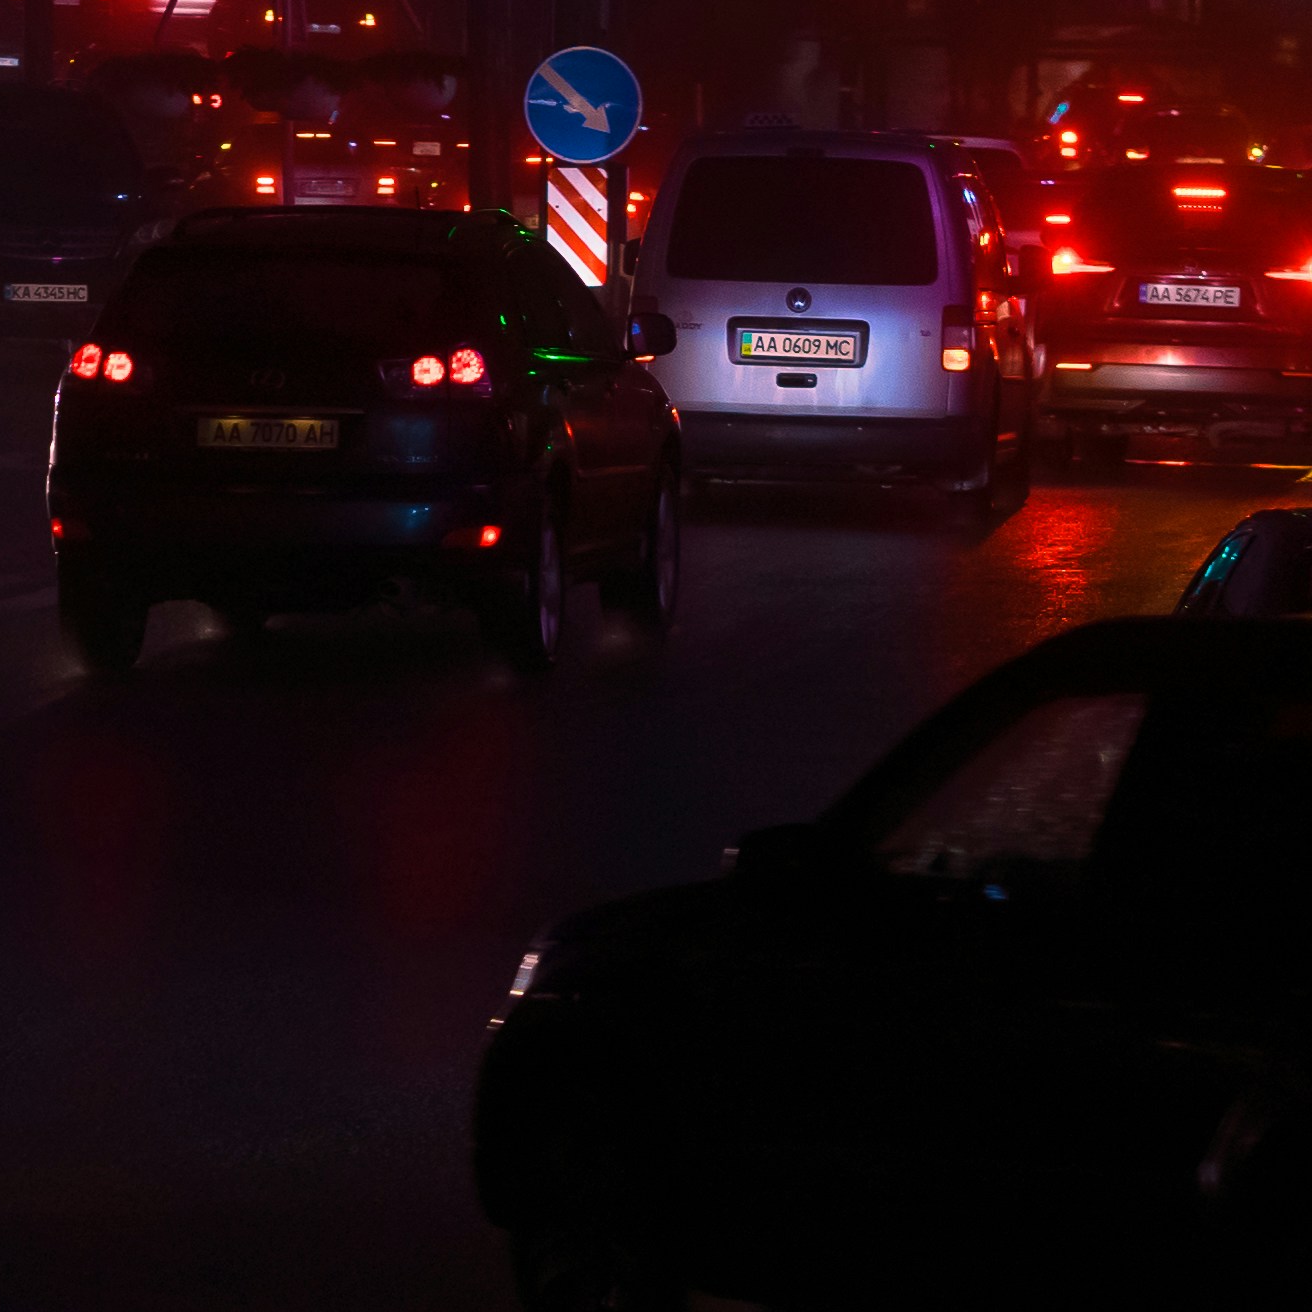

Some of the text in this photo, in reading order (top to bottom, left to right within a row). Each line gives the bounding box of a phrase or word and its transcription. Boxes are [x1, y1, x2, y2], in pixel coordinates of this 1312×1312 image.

[12, 286, 86, 300] KA 4345 HC
[1149, 287, 1235, 304] AA 5674 PE
[754, 336, 851, 356] AA 0609 MC
[213, 421, 334, 444] AA 7070 AH
